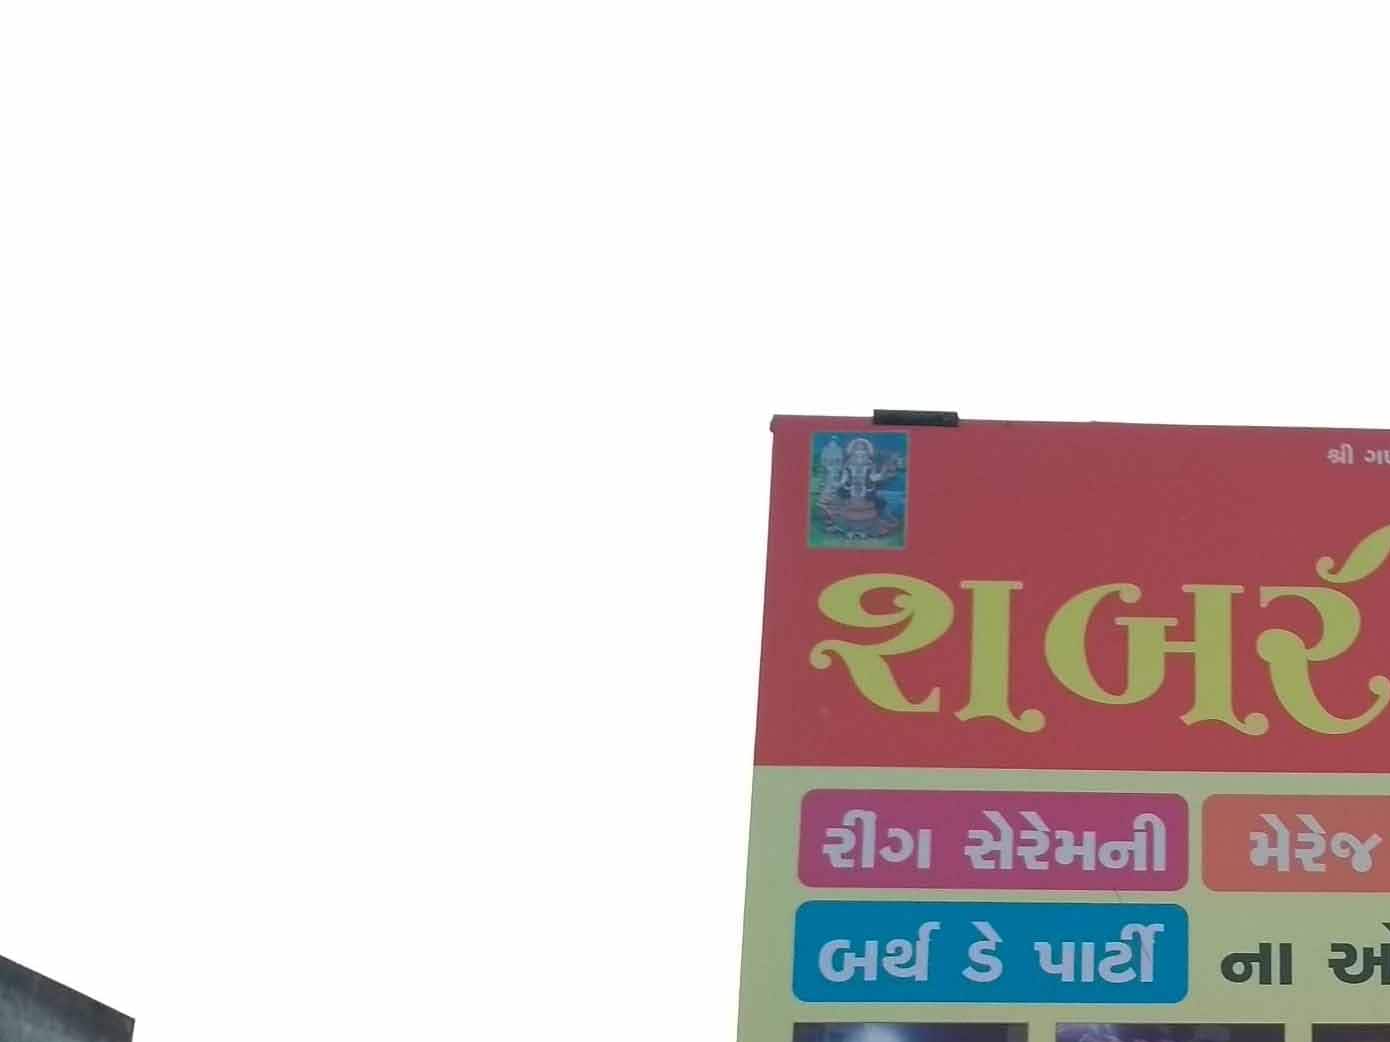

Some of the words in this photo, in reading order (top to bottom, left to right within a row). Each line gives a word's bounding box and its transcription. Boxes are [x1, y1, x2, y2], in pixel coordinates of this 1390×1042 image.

[1327, 442, 1354, 466] શ્રી
[821, 808, 934, 869] રીગ
[963, 809, 1167, 872] સેરેમની
[1248, 812, 1383, 873] મેરેજ
[817, 921, 942, 983] બર્થ
[961, 921, 1005, 983] ડે
[1033, 922, 1166, 983] પાર્ટી
[1219, 941, 1294, 986] ના
